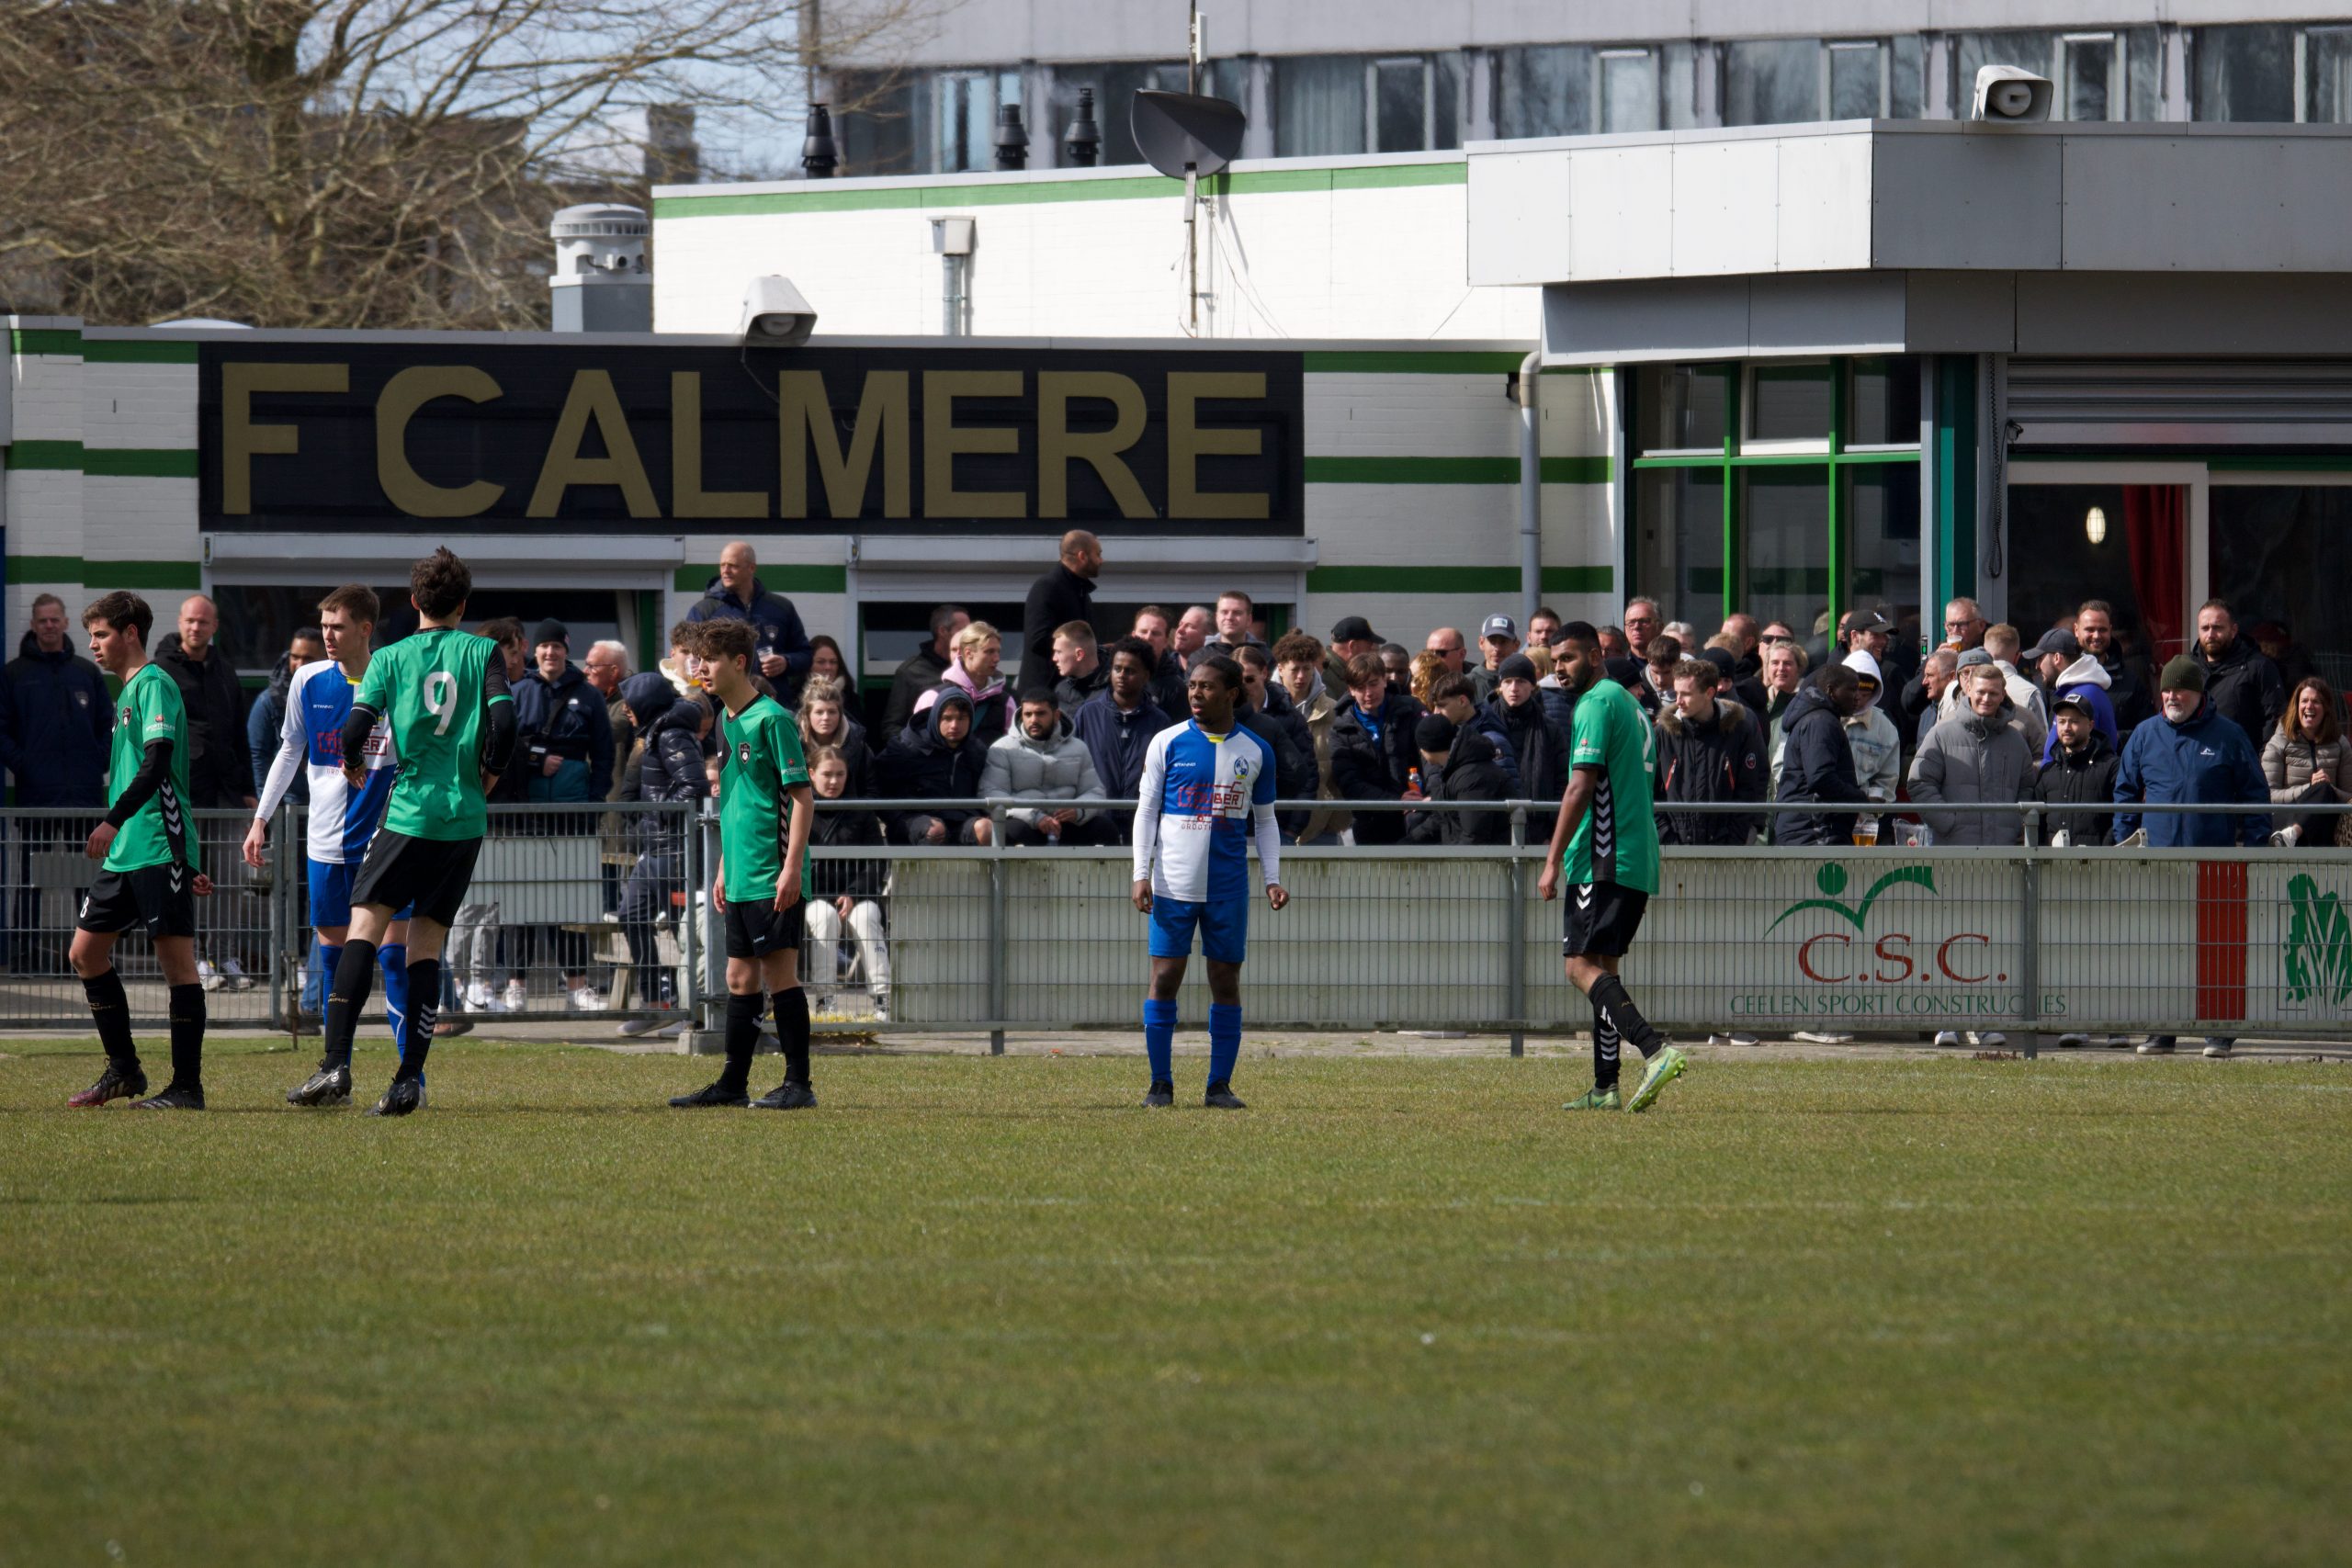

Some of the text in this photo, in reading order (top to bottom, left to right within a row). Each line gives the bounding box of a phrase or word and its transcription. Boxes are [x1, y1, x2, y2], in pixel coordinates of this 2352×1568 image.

[424, 671, 458, 736] 9
[80, 896, 90, 919] 8
[1798, 933, 2007, 983] C.S.C.
[1731, 994, 2066, 1014] CEELEN SPORT CONSTRUCIES
